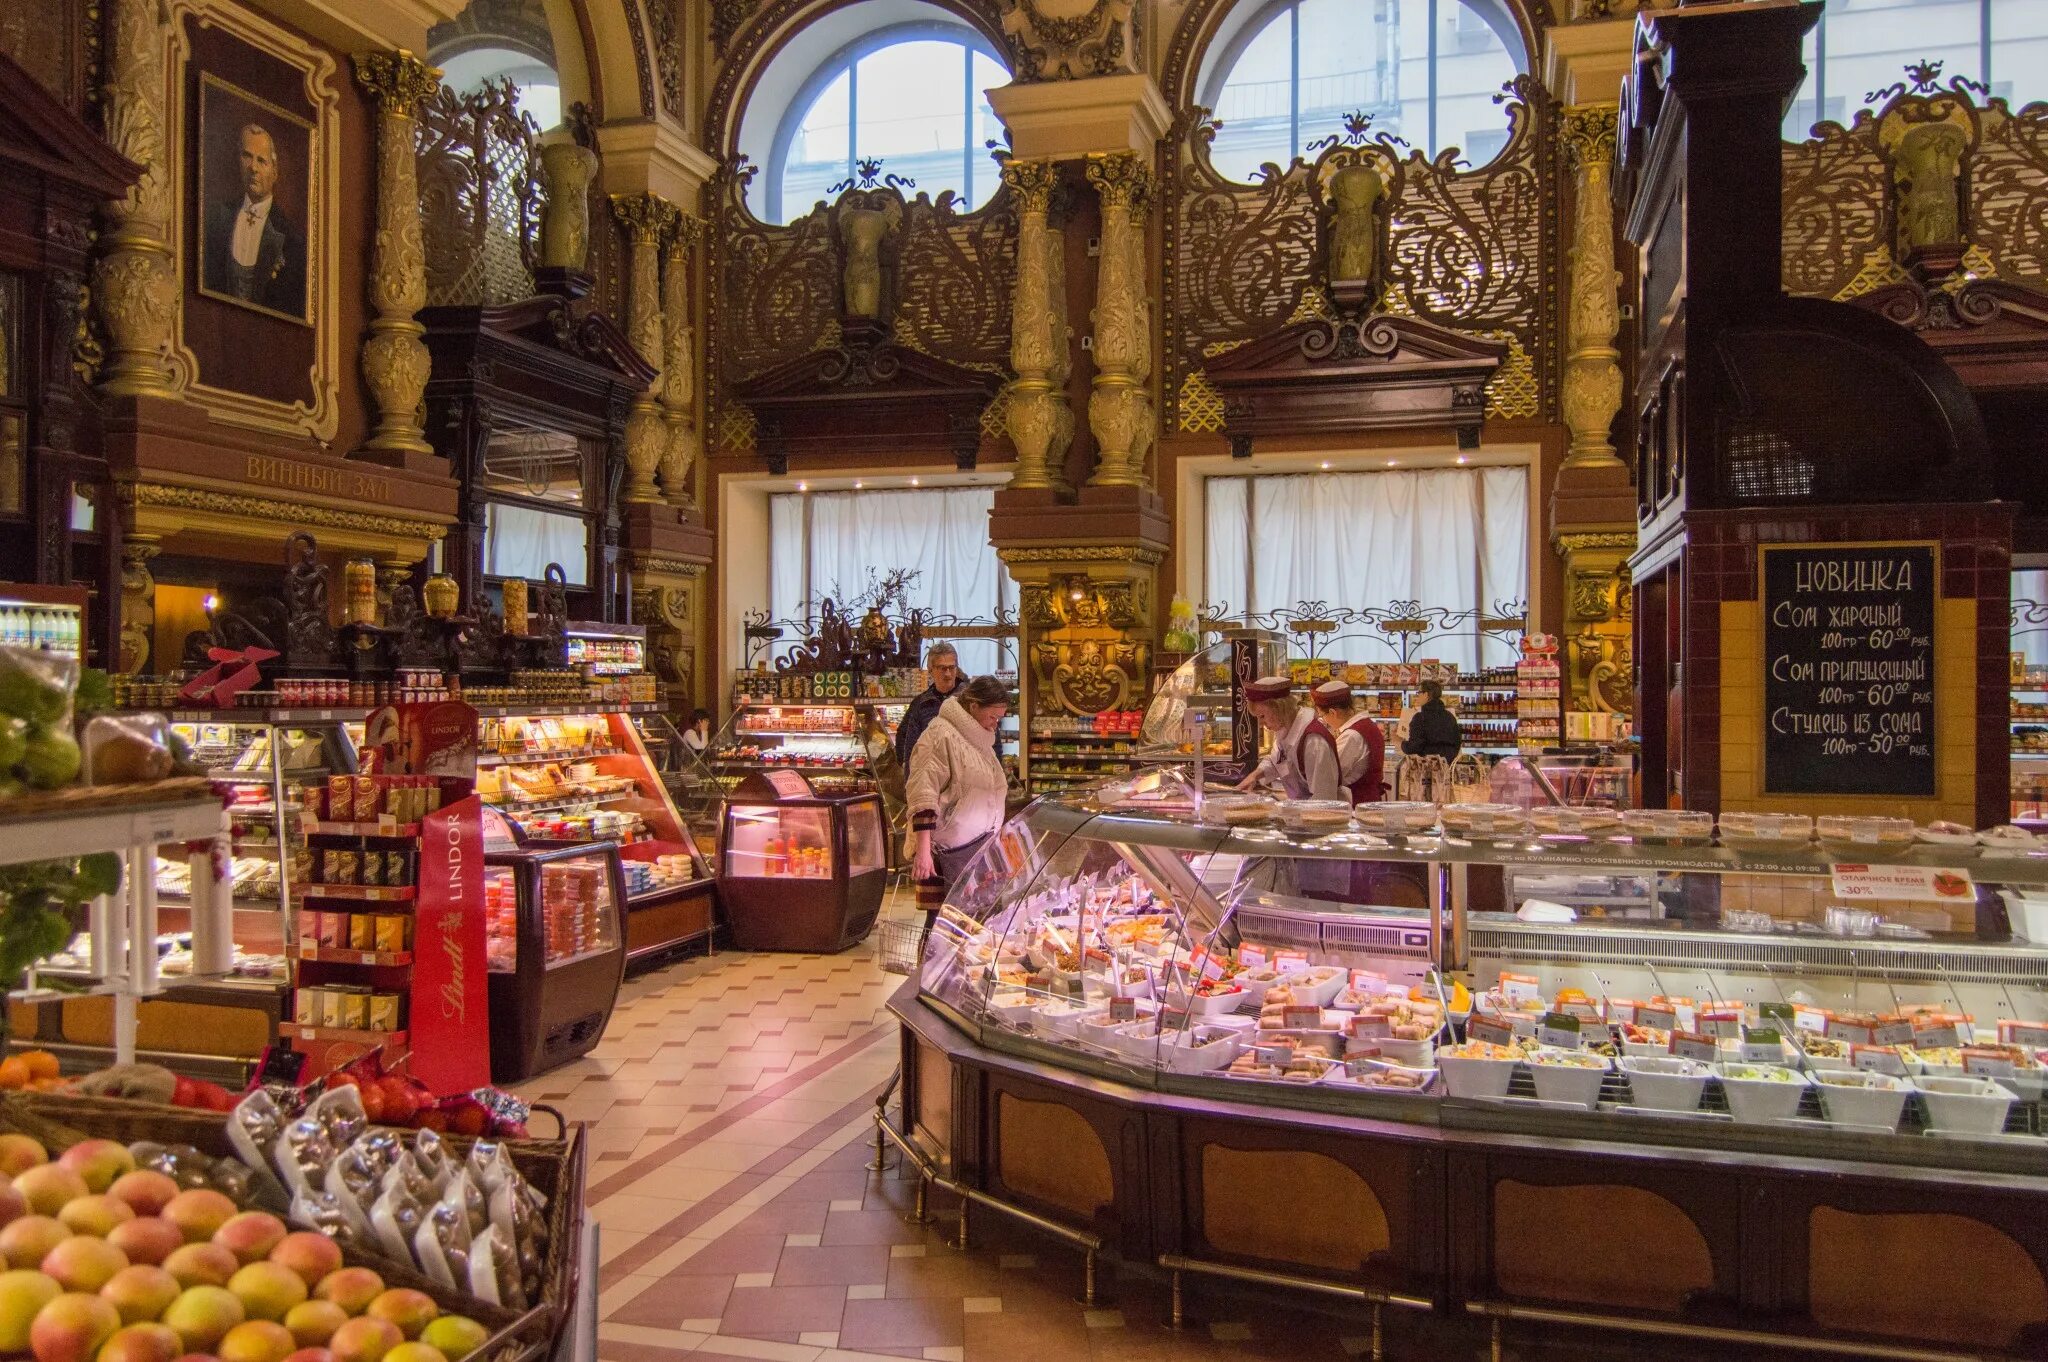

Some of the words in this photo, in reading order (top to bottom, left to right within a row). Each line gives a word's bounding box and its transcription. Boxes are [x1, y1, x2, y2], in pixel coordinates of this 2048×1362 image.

[247, 456, 346, 493] ВИННЫЙ
[352, 475, 390, 500] ЗАЛ
[1796, 560, 1912, 592] НОВИНКА
[431, 725, 460, 734] LINDOR
[447, 813, 463, 901] LINDOR
[1527, 855, 1582, 863] КУЛИНАРИЮ
[1584, 857, 1653, 865] СОБСТВЕННОГО
[1655, 859, 1726, 868] ПРОИЗВОДСТВА
[1840, 875, 1892, 883] ОТЛИЧНОЕ
[1841, 886, 1873, 895] -30%
[440, 935, 465, 1025] Lindt
